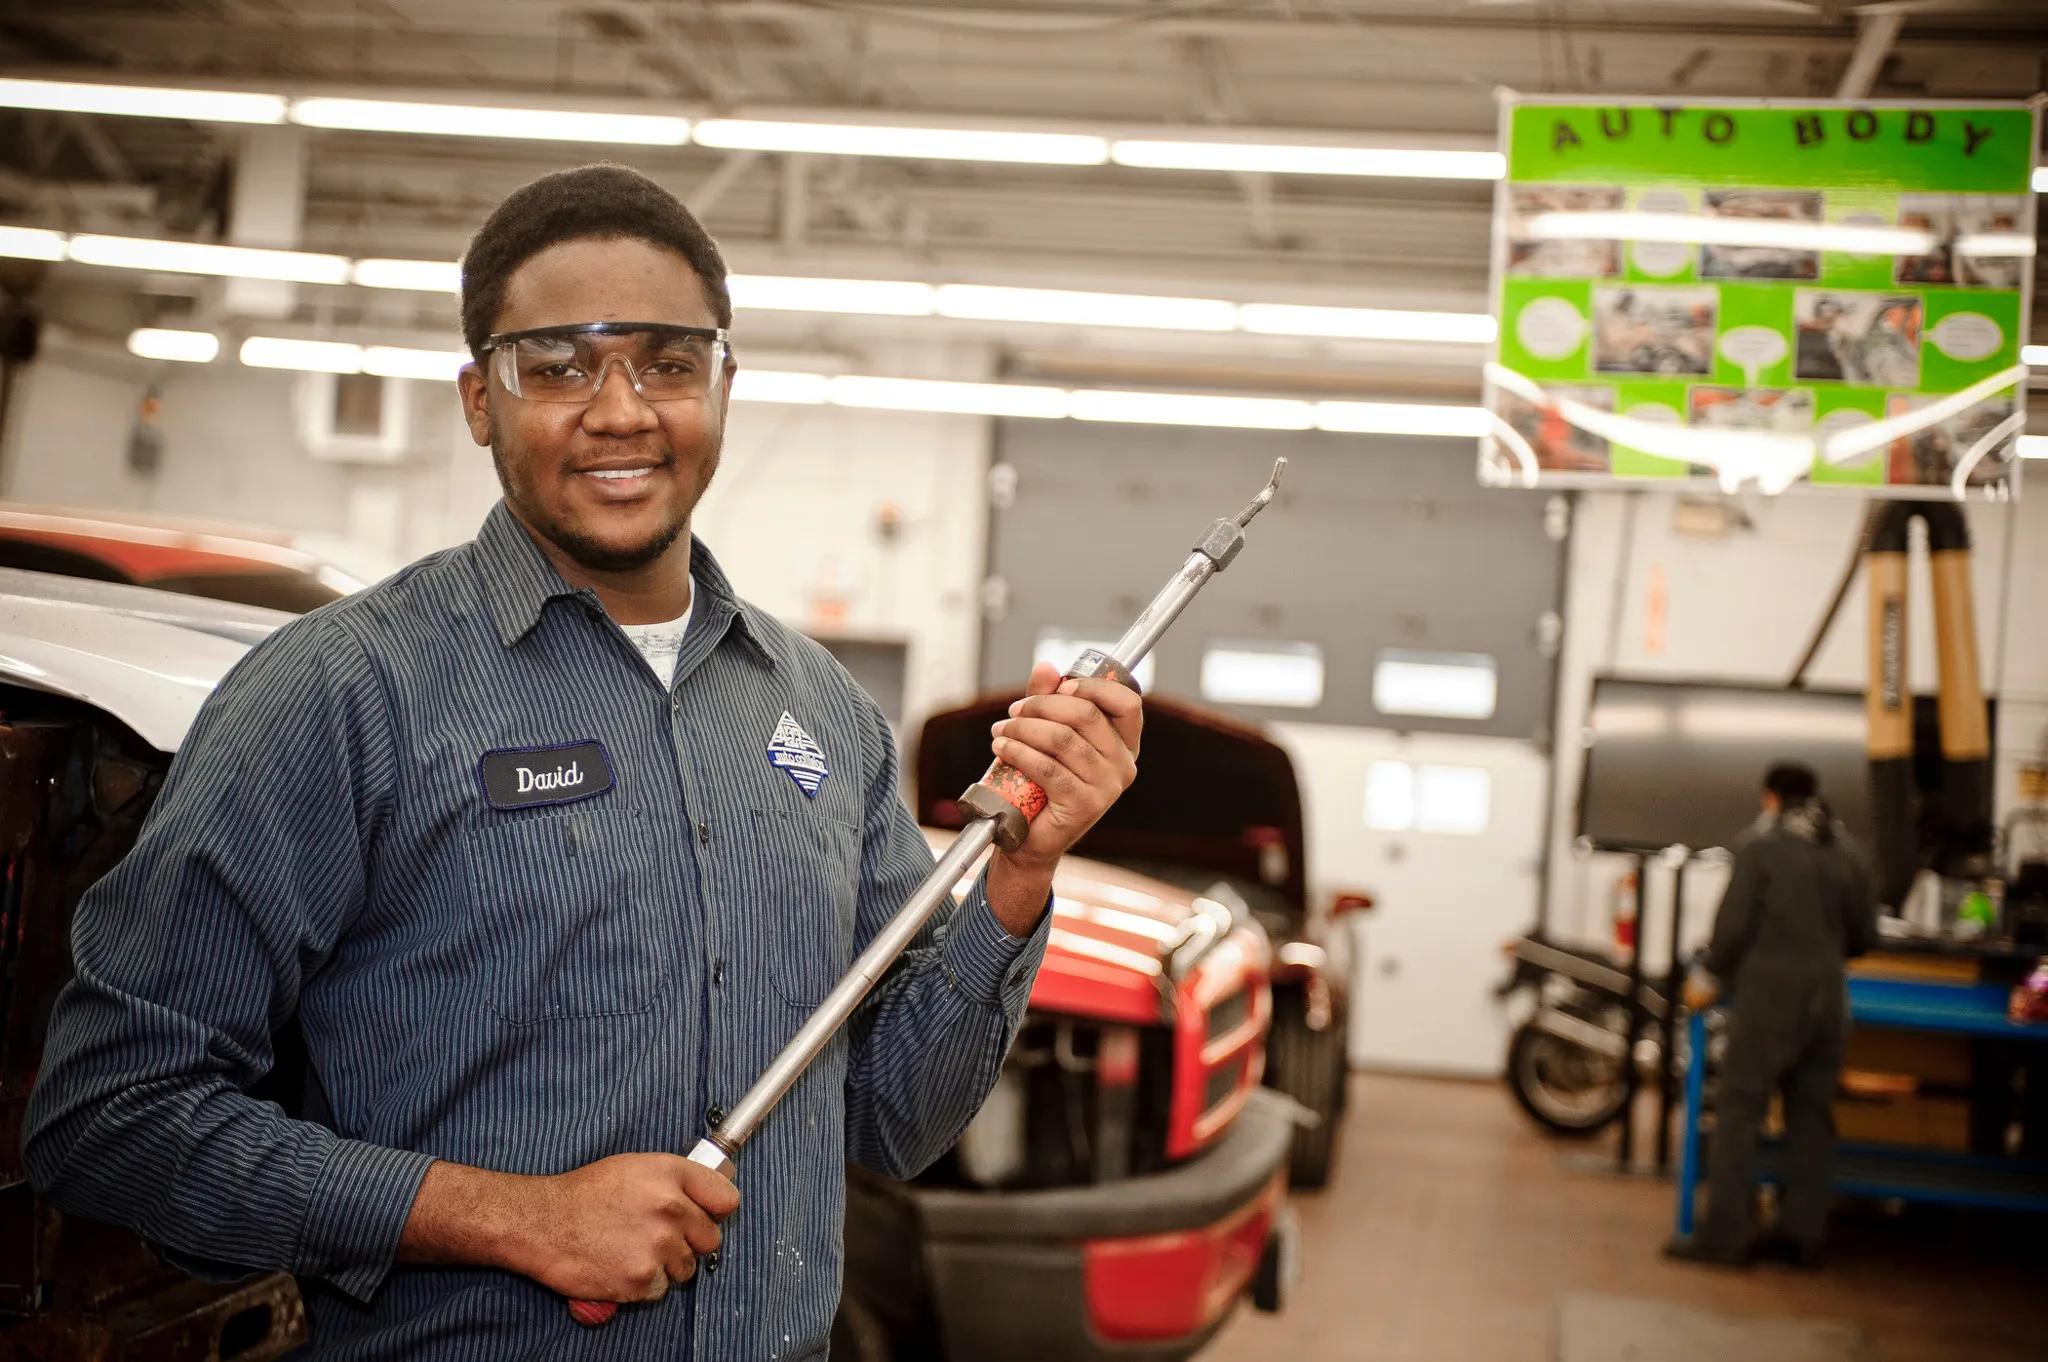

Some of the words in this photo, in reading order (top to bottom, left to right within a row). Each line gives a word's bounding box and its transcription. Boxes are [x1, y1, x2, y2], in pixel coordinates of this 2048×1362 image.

[1552, 104, 1736, 153] AUTO
[1795, 108, 1994, 157] BODY
[516, 760, 584, 793] David
